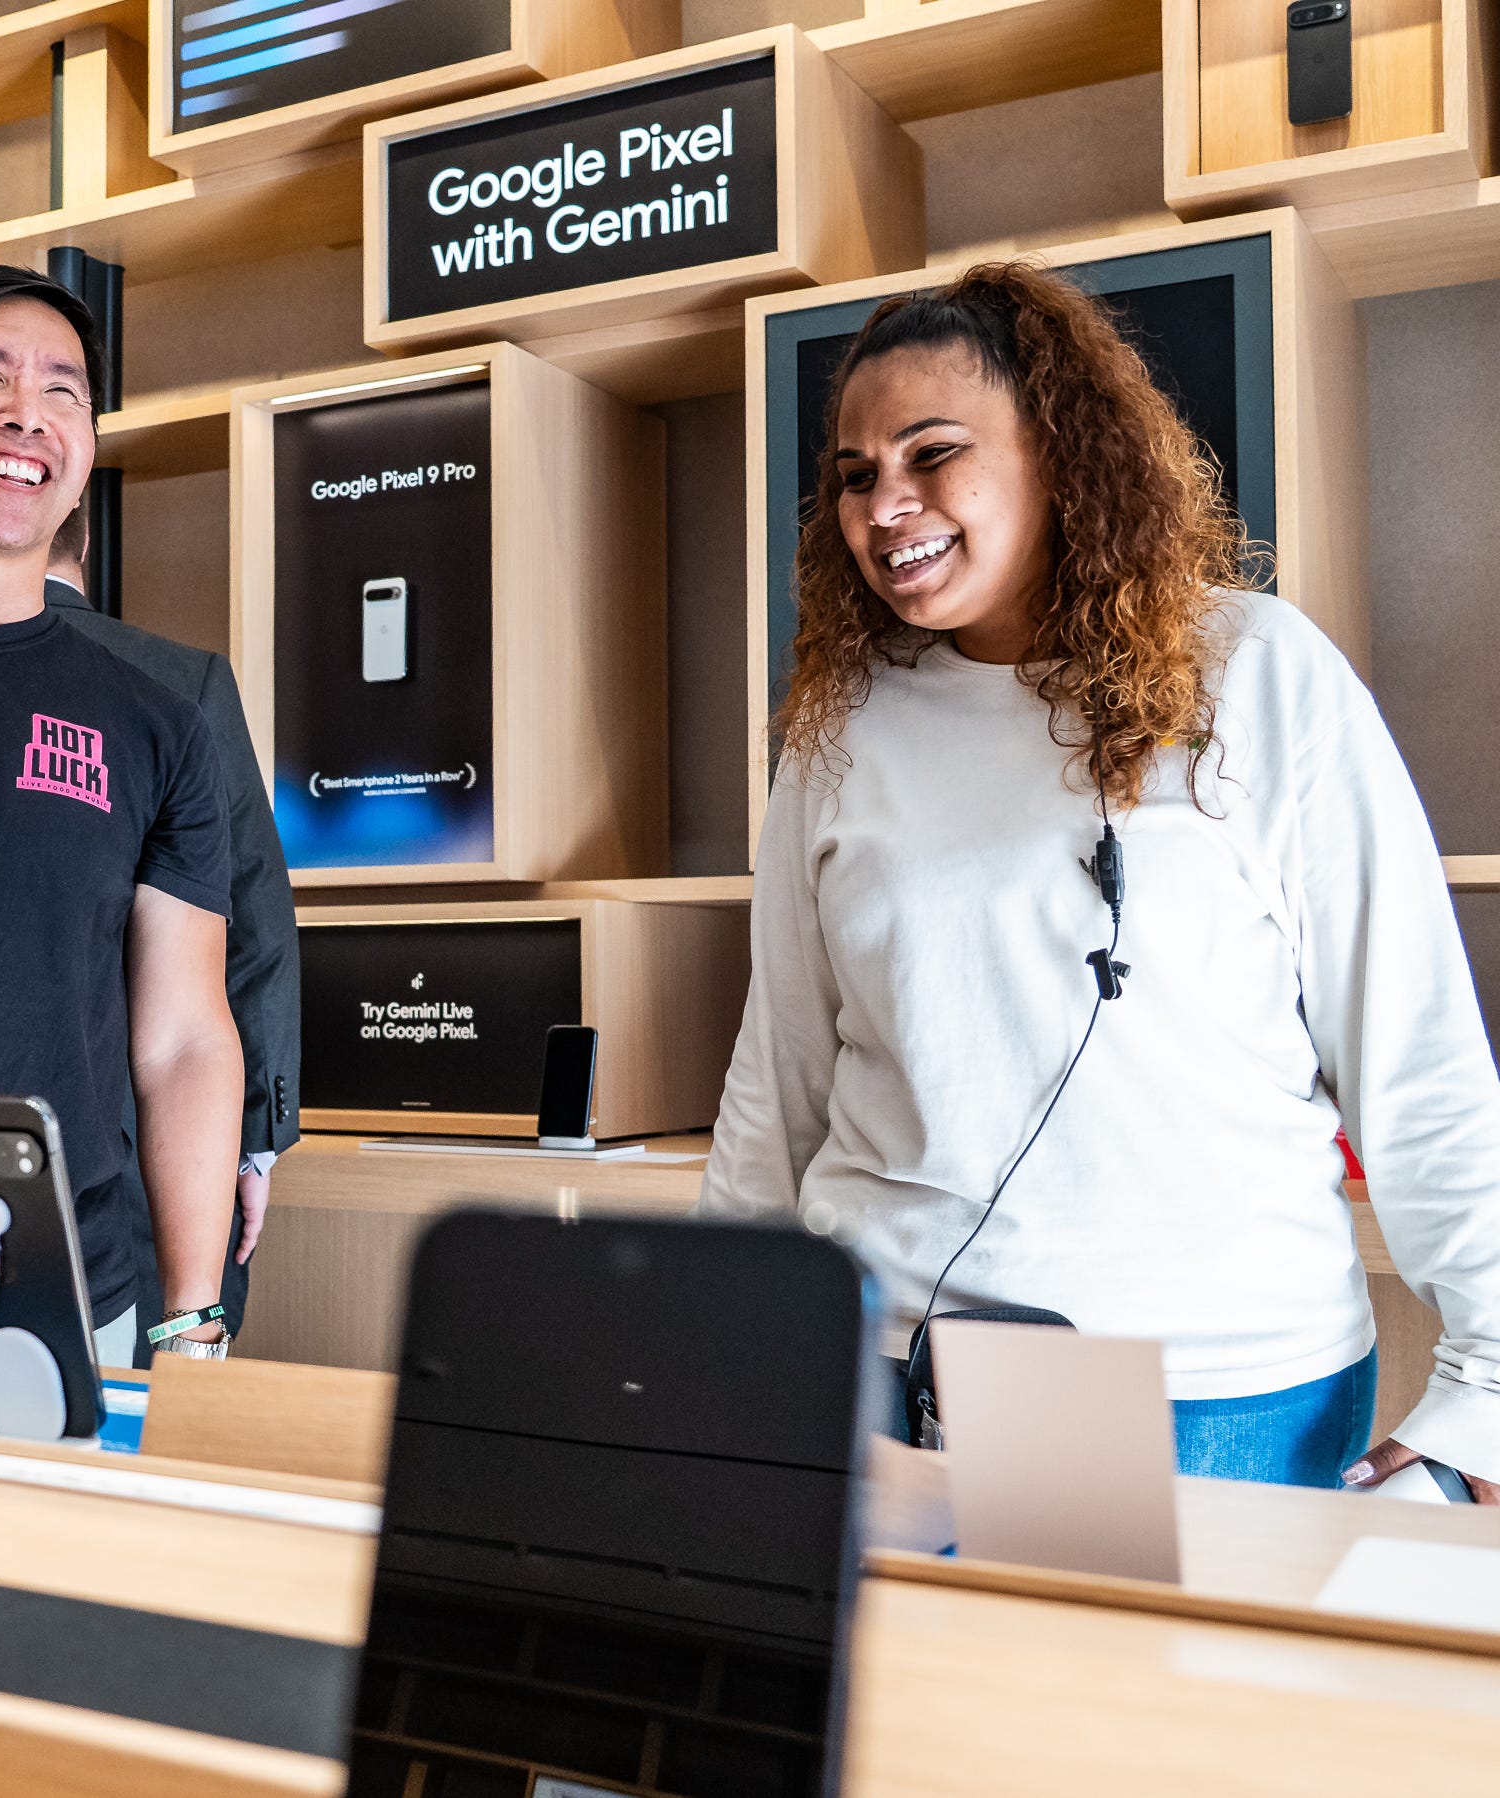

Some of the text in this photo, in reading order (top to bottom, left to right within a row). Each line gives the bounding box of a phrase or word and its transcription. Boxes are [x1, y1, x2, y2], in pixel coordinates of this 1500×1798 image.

[428, 107, 734, 216] Google Pixel
[431, 173, 729, 277] with Gemini
[311, 462, 476, 501] Google Pixel 9 Pro
[40, 718, 95, 759] HOT
[31, 748, 102, 796] LUCK
[343, 774, 393, 788] Smartphone
[394, 774, 401, 784] 2
[401, 772, 424, 784] Years
[21, 780, 42, 788] LIVE
[47, 784, 71, 794] FOOD
[85, 794, 108, 809] MUSIC
[360, 1002, 474, 1023] Try Gemini Live
[360, 1022, 478, 1043] on Google Pixel.
